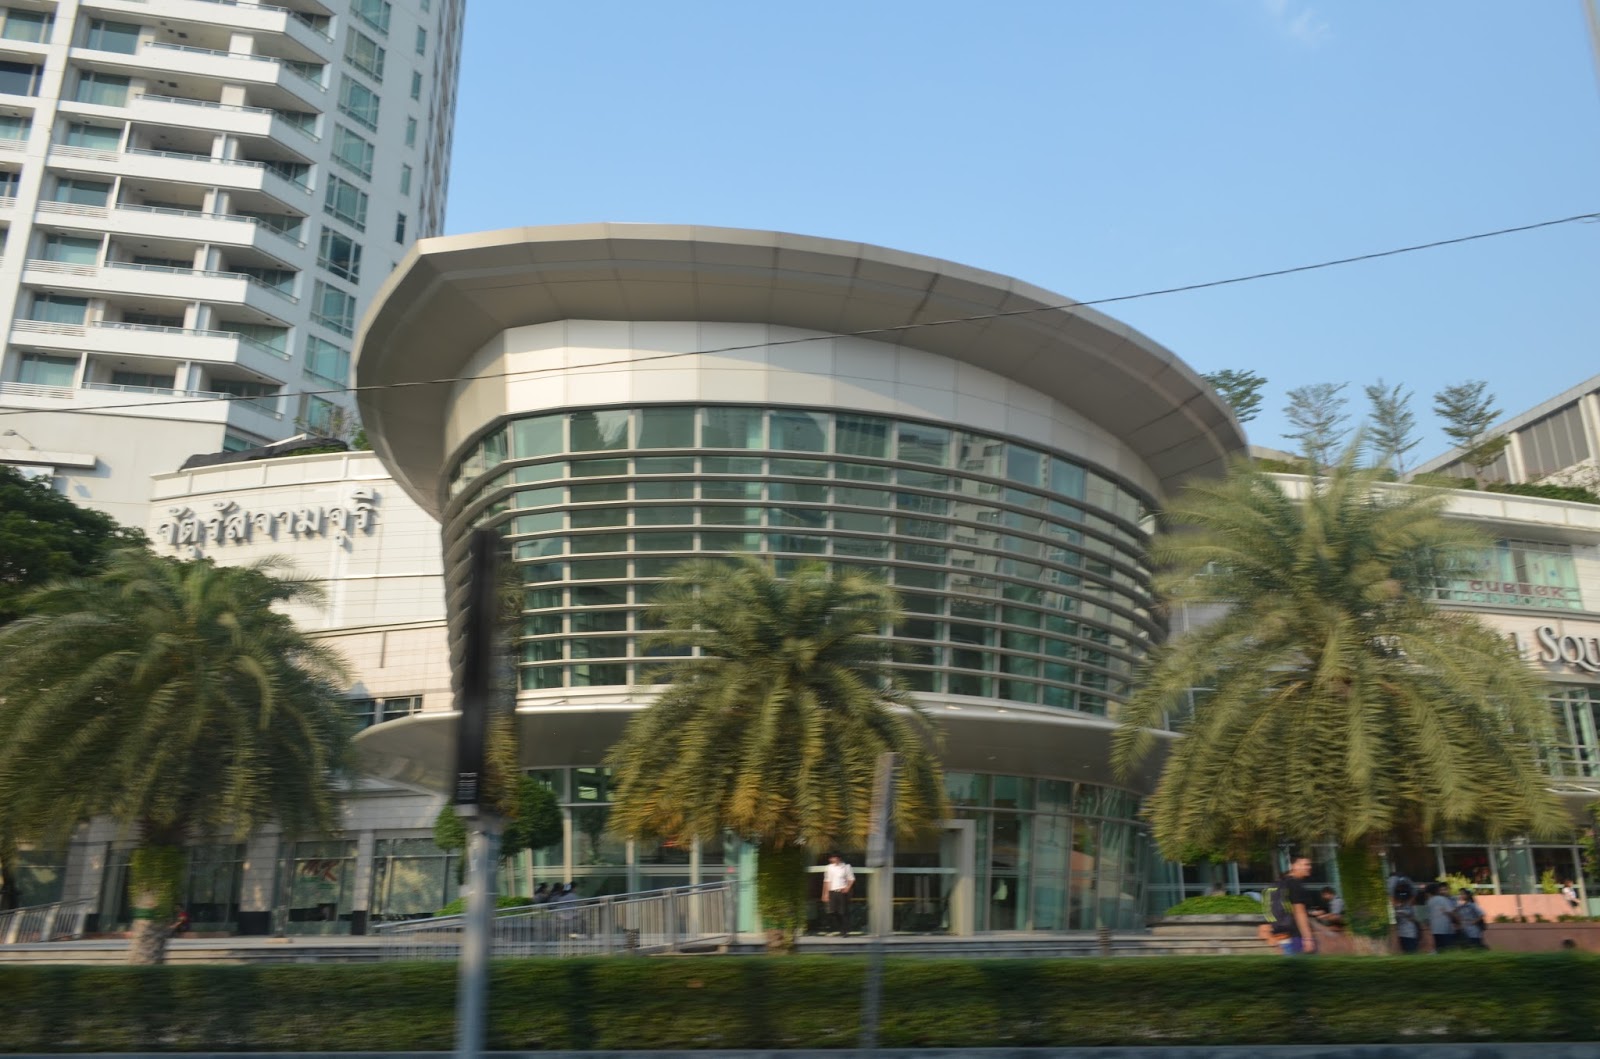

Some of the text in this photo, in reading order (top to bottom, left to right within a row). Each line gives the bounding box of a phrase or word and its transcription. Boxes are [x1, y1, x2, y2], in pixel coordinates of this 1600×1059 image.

[156, 487, 374, 557] จัตุรัสจามจุรี
